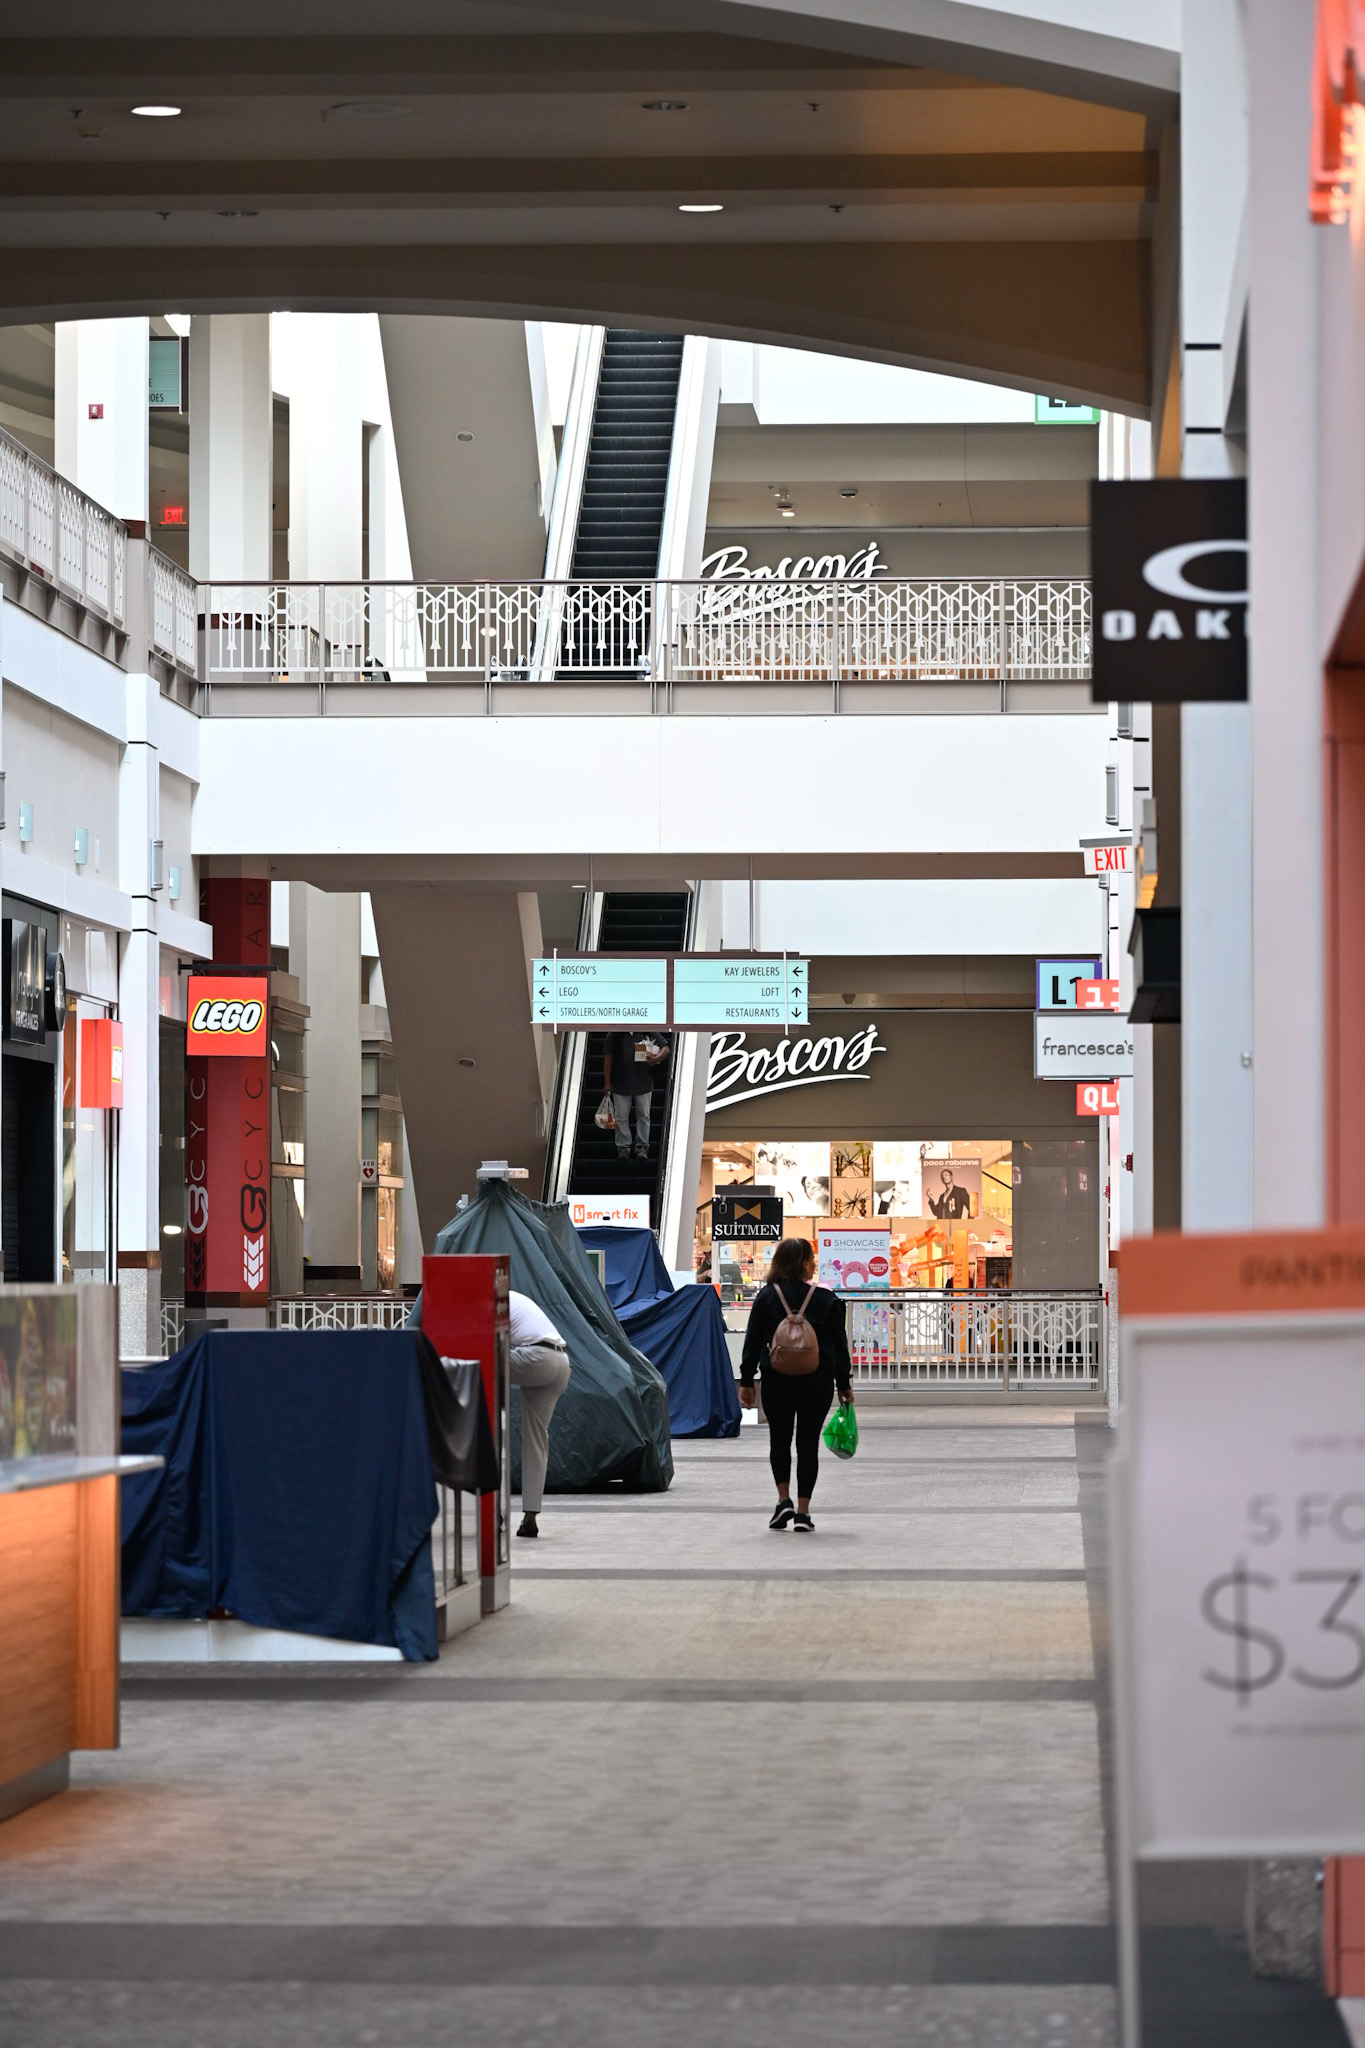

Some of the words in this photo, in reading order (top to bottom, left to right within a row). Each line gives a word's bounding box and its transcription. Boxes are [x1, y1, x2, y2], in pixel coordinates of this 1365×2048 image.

[149, 393, 164, 403] OES
[164, 508, 184, 523] EXIT
[1102, 609, 1248, 641] OAK
[1094, 847, 1127, 871] EXIT
[560, 965, 597, 975] BOSCOV'S
[724, 967, 740, 976] KAY
[741, 967, 780, 976] JEWELERS
[559, 987, 579, 996] LEGO
[761, 987, 780, 996] LOFT
[192, 1000, 263, 1032] LEGO
[560, 1007, 621, 1017] STROLLERS/NORTH
[622, 1007, 648, 1017] GARAGE
[725, 1008, 780, 1017] RESTAURANTS
[1042, 1037, 1133, 1056] francesca's
[705, 1024, 887, 1098] Boscov's
[1084, 1086, 1119, 1112] QL
[623, 1208, 639, 1220] fix
[834, 1239, 886, 1247] SHOWCASE
[1246, 1492, 1283, 1546] 5
